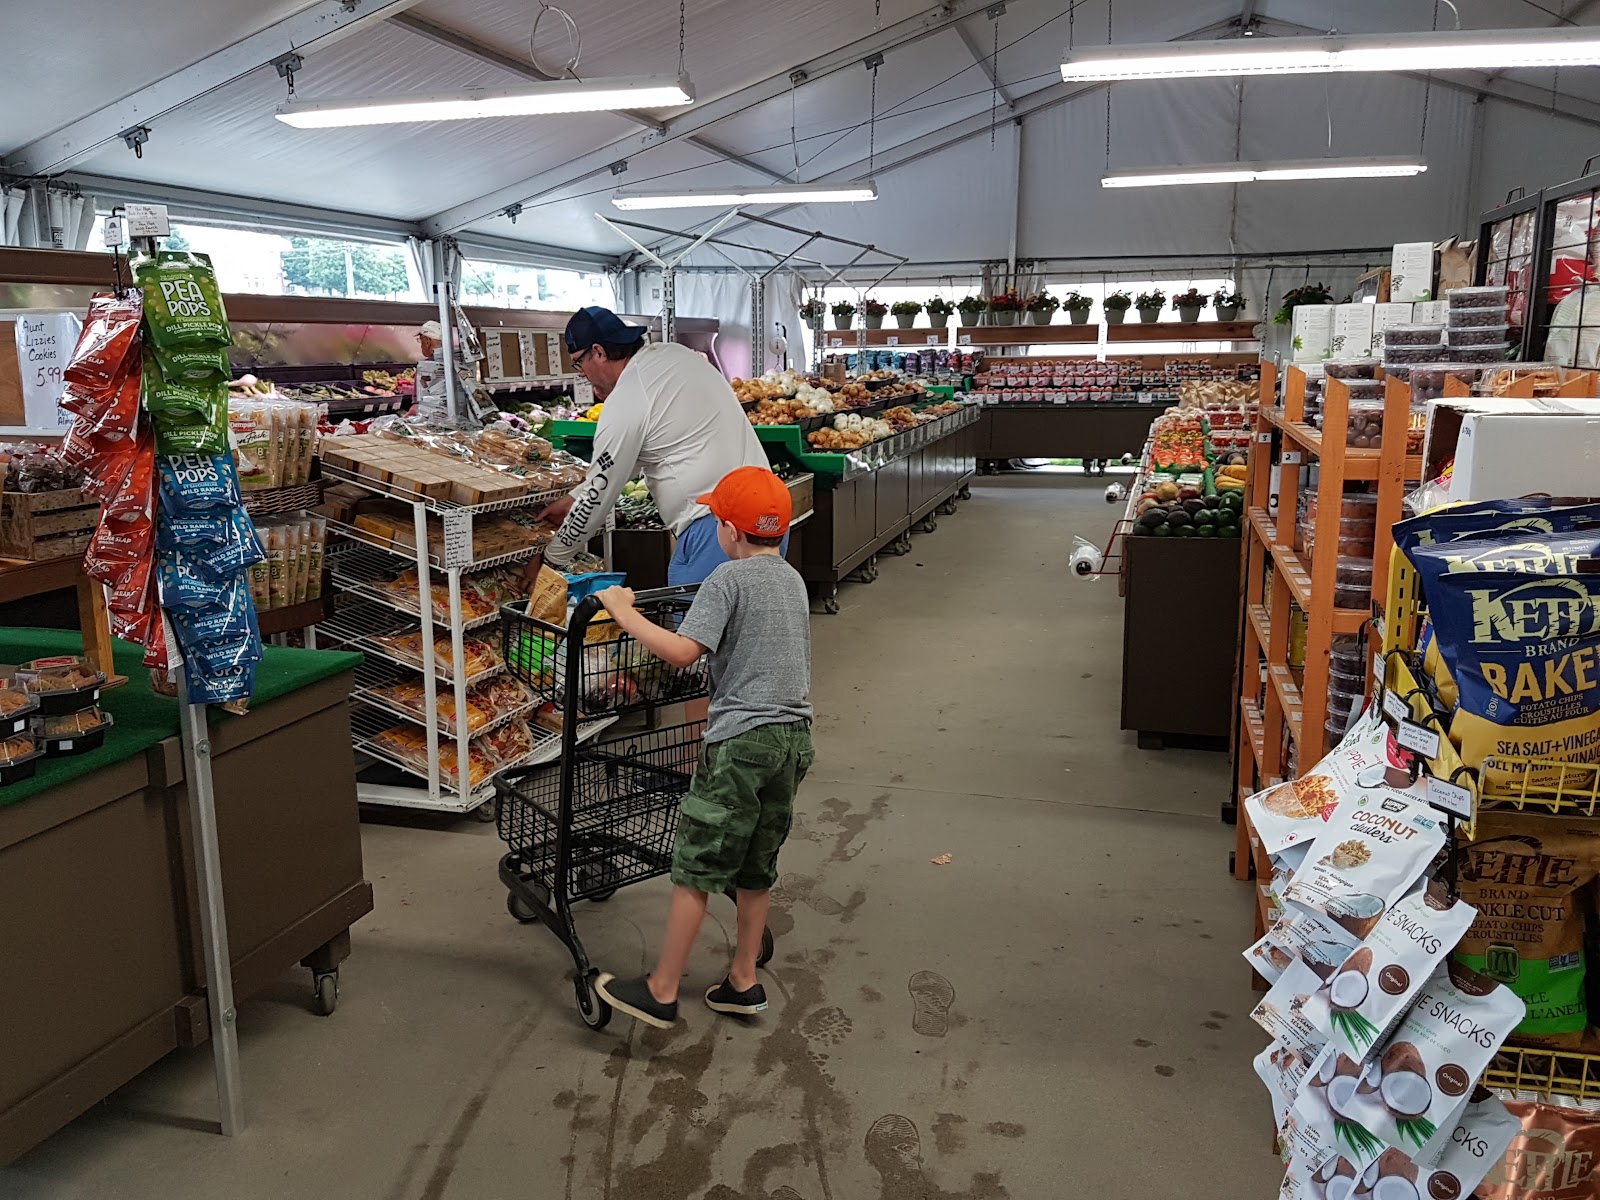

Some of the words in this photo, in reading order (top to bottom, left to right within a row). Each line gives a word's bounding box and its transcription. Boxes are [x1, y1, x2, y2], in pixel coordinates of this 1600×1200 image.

[159, 280, 205, 301] PEA
[167, 300, 211, 316] POPS
[23, 321, 45, 333] Aunt
[166, 324, 182, 333] DILL
[26, 334, 56, 347] Lizzies
[28, 348, 56, 362] Cookies
[87, 356, 104, 364] SLAP
[172, 354, 187, 362] DILL
[36, 366, 60, 386] 5.99
[156, 390, 172, 398] DILL
[173, 390, 197, 401] PICKLE
[258, 447, 264, 456] 8
[175, 467, 218, 484] POPS
[180, 488, 200, 496] WILD
[560, 473, 608, 546] Columbia
[208, 554, 226, 564] WILD
[271, 567, 278, 576] 8
[206, 652, 224, 660] WILD
[225, 646, 248, 654] RANCH
[1525, 638, 1580, 657] BRAND
[1480, 645, 1600, 704] BAKE
[206, 684, 225, 692] WILD
[225, 682, 244, 690] RANCH
[1520, 699, 1557, 712] POTATO
[1558, 693, 1584, 704] CHIPS
[1514, 712, 1548, 724] CUITES
[1550, 711, 1564, 721] AU
[1565, 706, 1589, 718] FOUR
[1520, 702, 1582, 719] CROUSTILLES
[1497, 740, 1520, 756] SEA
[1402, 792, 1417, 800] TASTES
[1432, 784, 1450, 796] Coconut
[1352, 810, 1418, 840] COCONUT
[1350, 822, 1392, 844] clusters
[1480, 888, 1529, 900] BRAND
[1528, 906, 1566, 922] CUT
[1393, 913, 1442, 954] SNACKS
[1470, 920, 1508, 930] OTATO
[1511, 922, 1544, 932] CHIPS
[1466, 930, 1543, 942] CROUSTILLES
[1385, 972, 1403, 988] Original
[1522, 992, 1550, 1004] KLE
[1430, 1002, 1496, 1048] SNACKS
[1442, 1072, 1464, 1087] Original
[1452, 1126, 1488, 1158] CKS
[1434, 1179, 1455, 1194] Original
